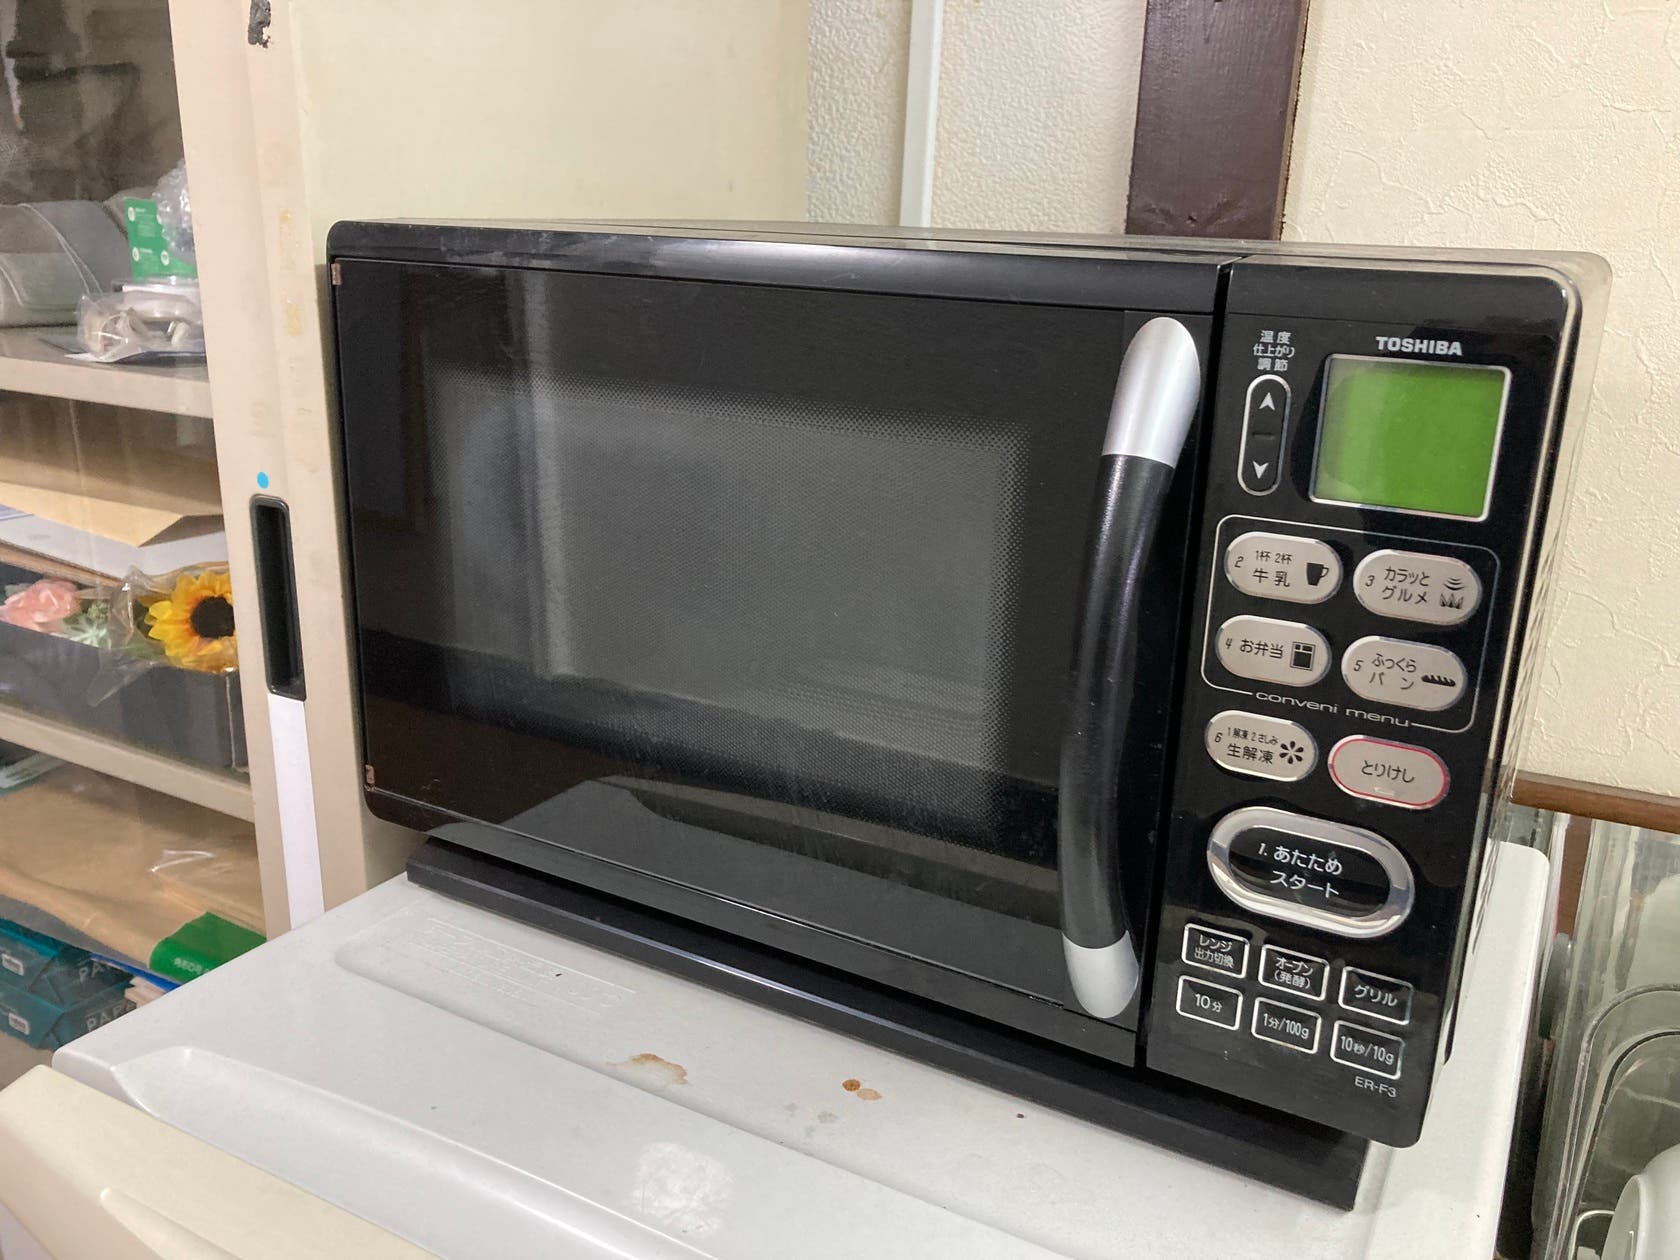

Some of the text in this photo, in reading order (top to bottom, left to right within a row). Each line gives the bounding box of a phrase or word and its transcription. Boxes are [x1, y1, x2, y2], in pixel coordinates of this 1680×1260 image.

[1260, 330, 1291, 344] 温度
[1376, 336, 1463, 356] TOSHIBA
[1253, 343, 1295, 358] 仕上がり
[1257, 357, 1289, 371] 調節
[1234, 556, 1244, 568] 2
[1252, 568, 1290, 587] 牛乳
[1365, 575, 1375, 587] 3
[1384, 566, 1431, 586] カラッと
[1381, 585, 1428, 604] グルメ
[1225, 638, 1233, 650] 4
[1240, 638, 1284, 659] お弁当
[1353, 660, 1364, 672] 5
[1371, 652, 1417, 672] ふっくら
[1369, 671, 1414, 690] パン
[1255, 692, 1409, 728] conveni menu
[1214, 732, 1223, 743] 6
[1227, 743, 1274, 765] 生解凍
[1361, 760, 1415, 783] とりけし
[1273, 845, 1342, 876] あたため
[1270, 870, 1340, 898] スタート
[1199, 934, 1233, 952] レンジ
[1194, 947, 1236, 969] 出力切換
[1274, 956, 1314, 976] オープン
[1195, 993, 1223, 1013] 10分
[1354, 984, 1398, 1007] グリル
[1263, 1013, 1310, 1040] 1分/100g
[1340, 1035, 1395, 1065] 10秒/10g
[1354, 1075, 1397, 1098] ER-F3
